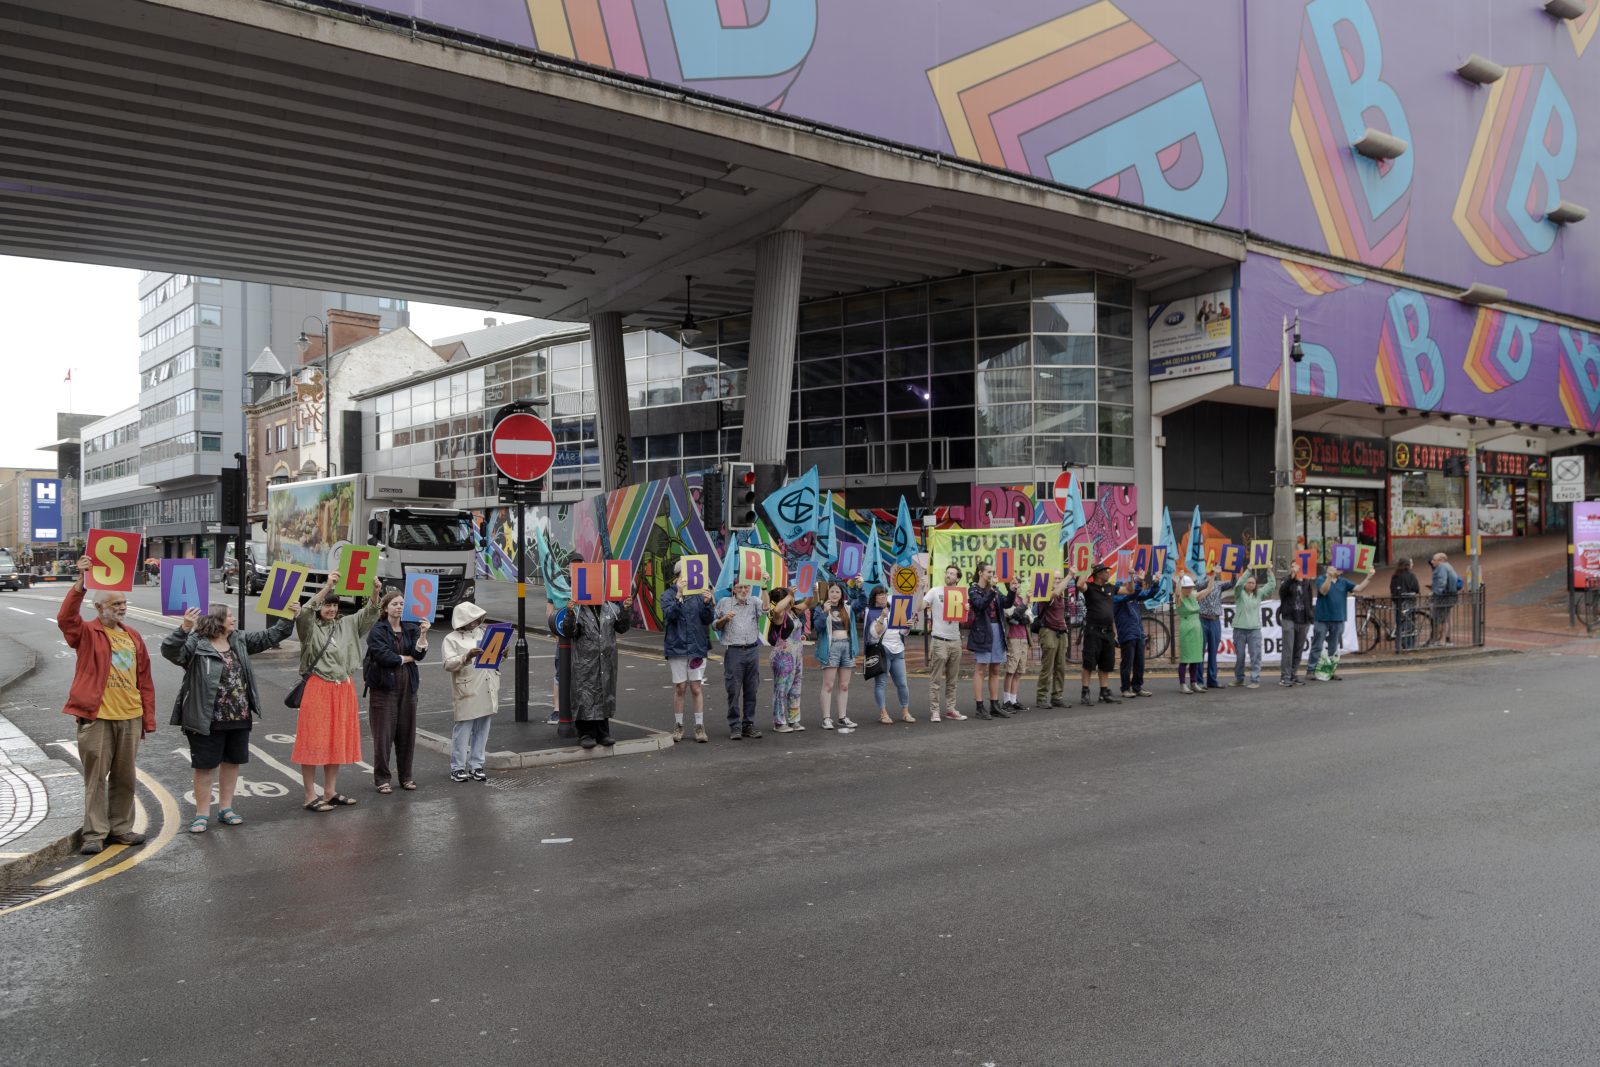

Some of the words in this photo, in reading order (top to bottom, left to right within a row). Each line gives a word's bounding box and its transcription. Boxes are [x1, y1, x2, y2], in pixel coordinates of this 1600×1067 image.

[1312, 437, 1338, 464] Fish
[1341, 439, 1350, 464] &
[1352, 440, 1386, 474] Chips
[1556, 492, 1581, 500] ENDS
[951, 533, 1047, 552] HOUSING
[951, 554, 996, 567] RETRO
[1020, 554, 1045, 567] FOR
[92, 536, 128, 585] S
[168, 564, 200, 611] A
[268, 567, 301, 611] V
[345, 550, 369, 591] E
